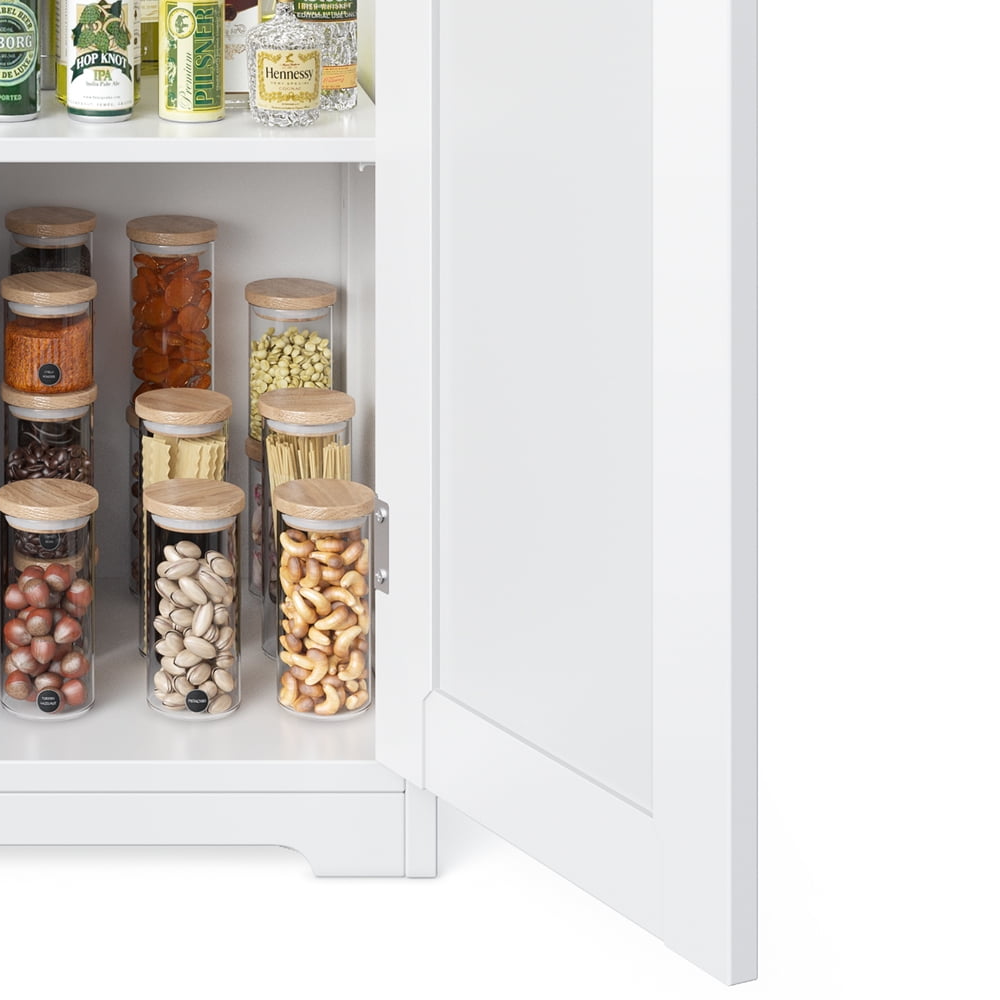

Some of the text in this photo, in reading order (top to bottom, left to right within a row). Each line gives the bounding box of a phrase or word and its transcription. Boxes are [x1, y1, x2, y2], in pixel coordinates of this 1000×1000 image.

[16, 11, 33, 29] BEER
[76, 53, 127, 70] HOP KNOT
[194, 7, 215, 106] PILSNER
[13, 57, 31, 76] LUXE
[93, 69, 112, 81] IPA
[265, 66, 314, 81] Hennessy
[179, 52, 193, 110] Premium
